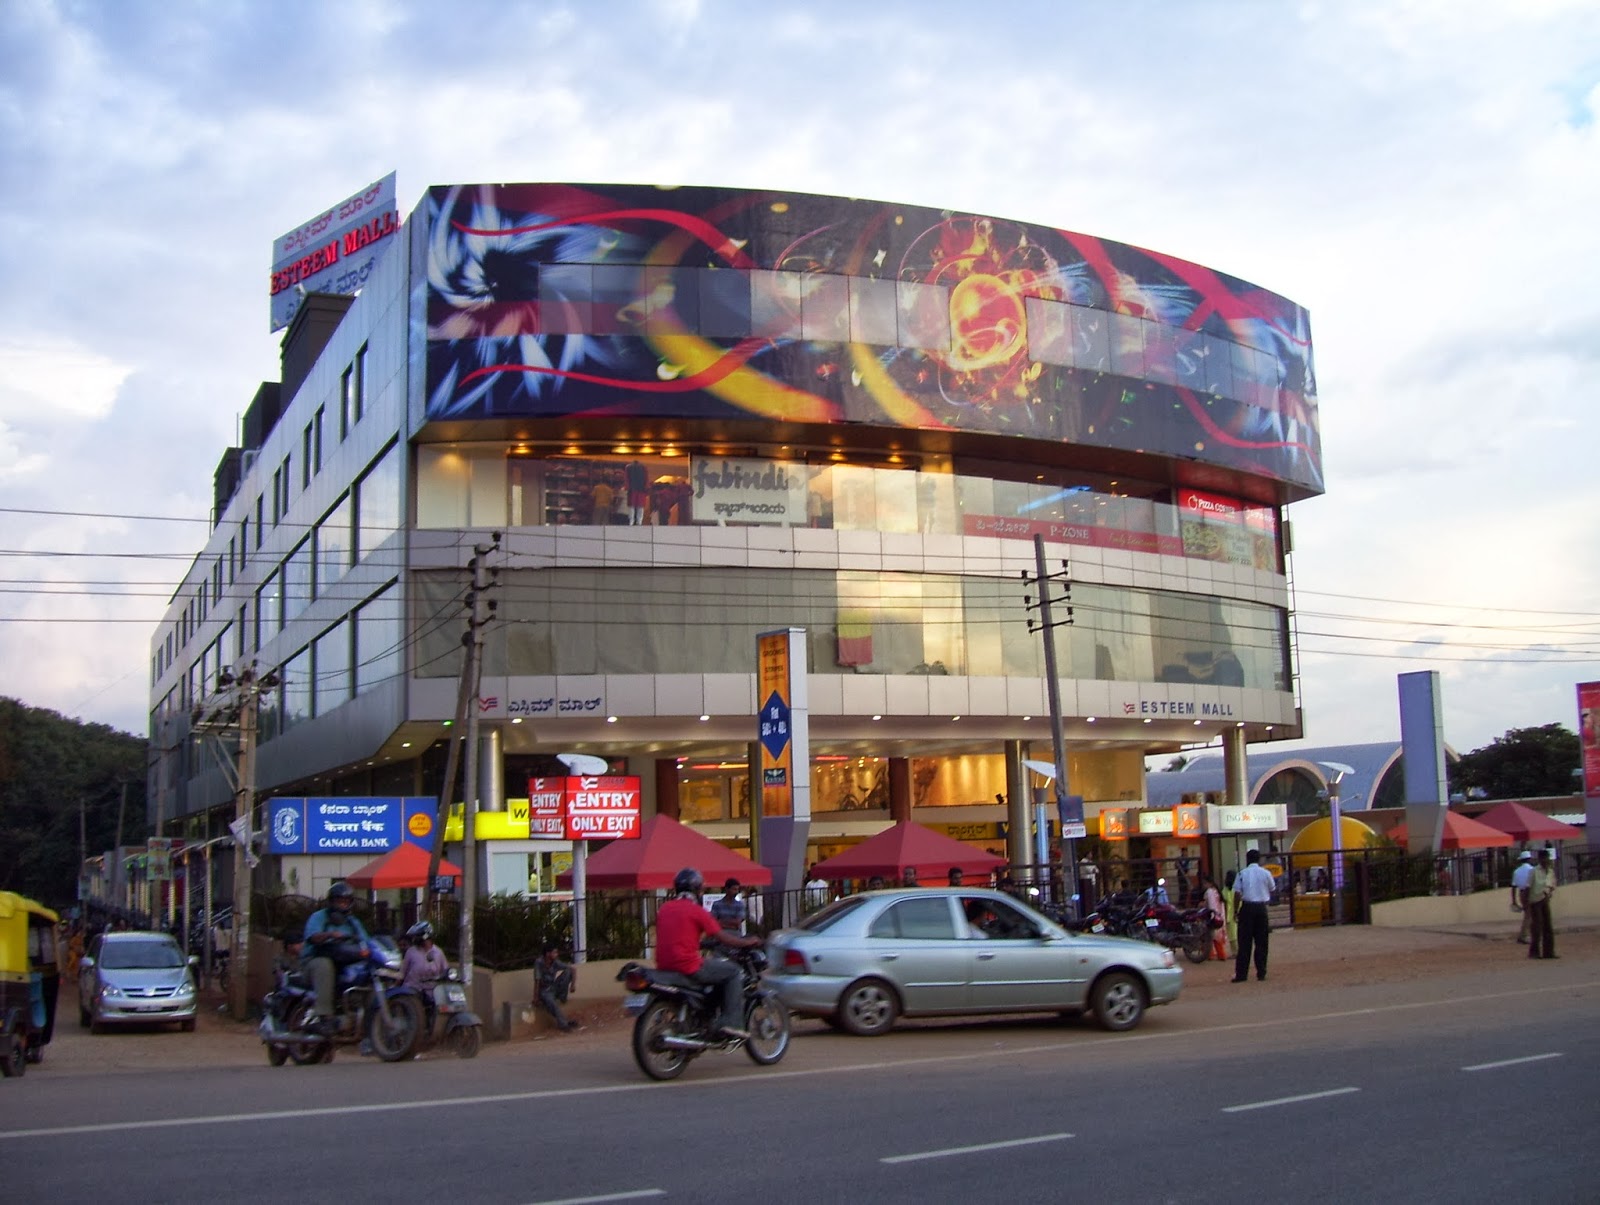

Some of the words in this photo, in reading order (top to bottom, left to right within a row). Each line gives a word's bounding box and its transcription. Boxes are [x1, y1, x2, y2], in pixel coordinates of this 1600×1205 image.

[270, 240, 340, 296] ESTEEM
[343, 210, 401, 255] MALL
[694, 459, 804, 499] fabindia
[1198, 498, 1214, 511] PIZZA
[1050, 524, 1089, 539] P-ZONE
[559, 697, 602, 711] ಮಾಲ್
[1141, 701, 1194, 714] ESTEEM
[1202, 703, 1233, 716] MALL
[532, 793, 562, 808] ENTRY
[575, 793, 634, 807] ENTRY
[324, 820, 360, 832] केनरा
[531, 818, 546, 832] ONLY
[546, 818, 562, 832] EXIT
[572, 817, 604, 830] ONLY
[607, 816, 635, 830] EXIT
[318, 837, 359, 848] CANARA
[360, 837, 390, 848] BANK
